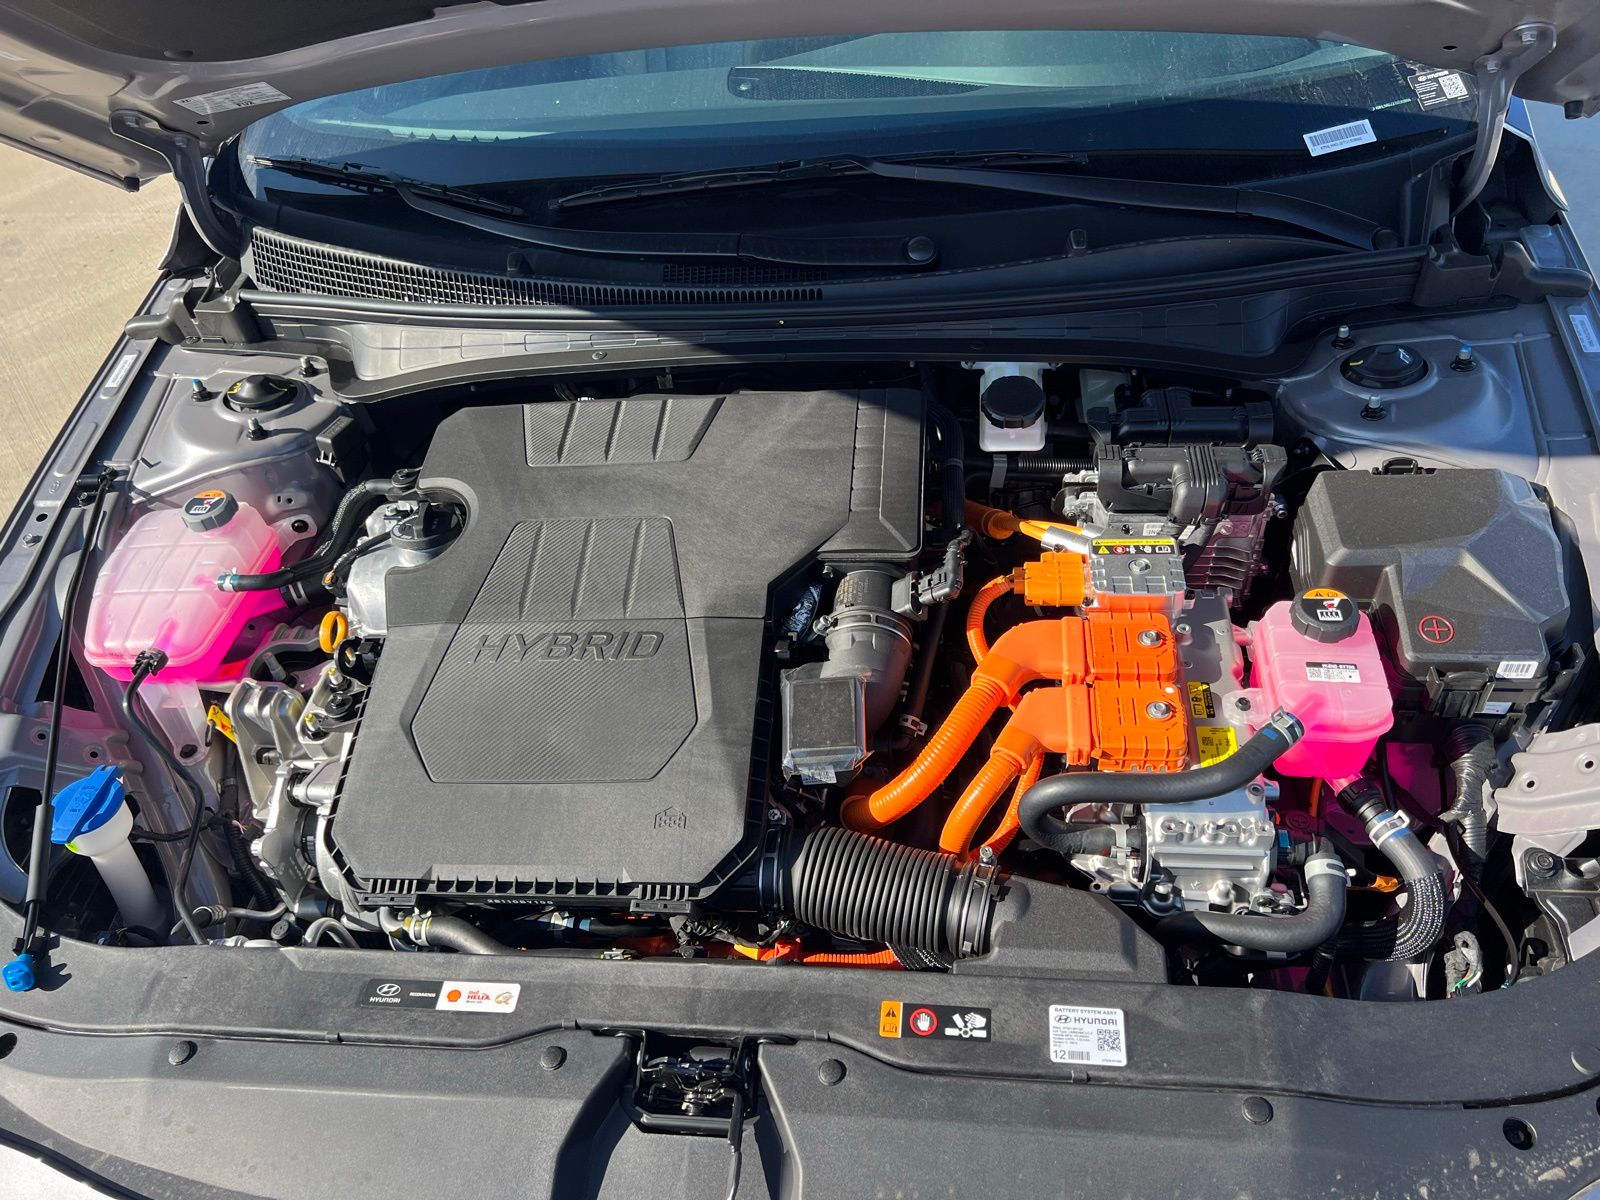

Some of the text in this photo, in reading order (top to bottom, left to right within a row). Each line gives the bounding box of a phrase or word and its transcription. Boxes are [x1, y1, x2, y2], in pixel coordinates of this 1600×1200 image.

[474, 631, 665, 664] HYBRID
[369, 996, 401, 1004] HYUNDAI
[1074, 1017, 1117, 1026] HYUNDAI
[1052, 1049, 1067, 1060] 12
